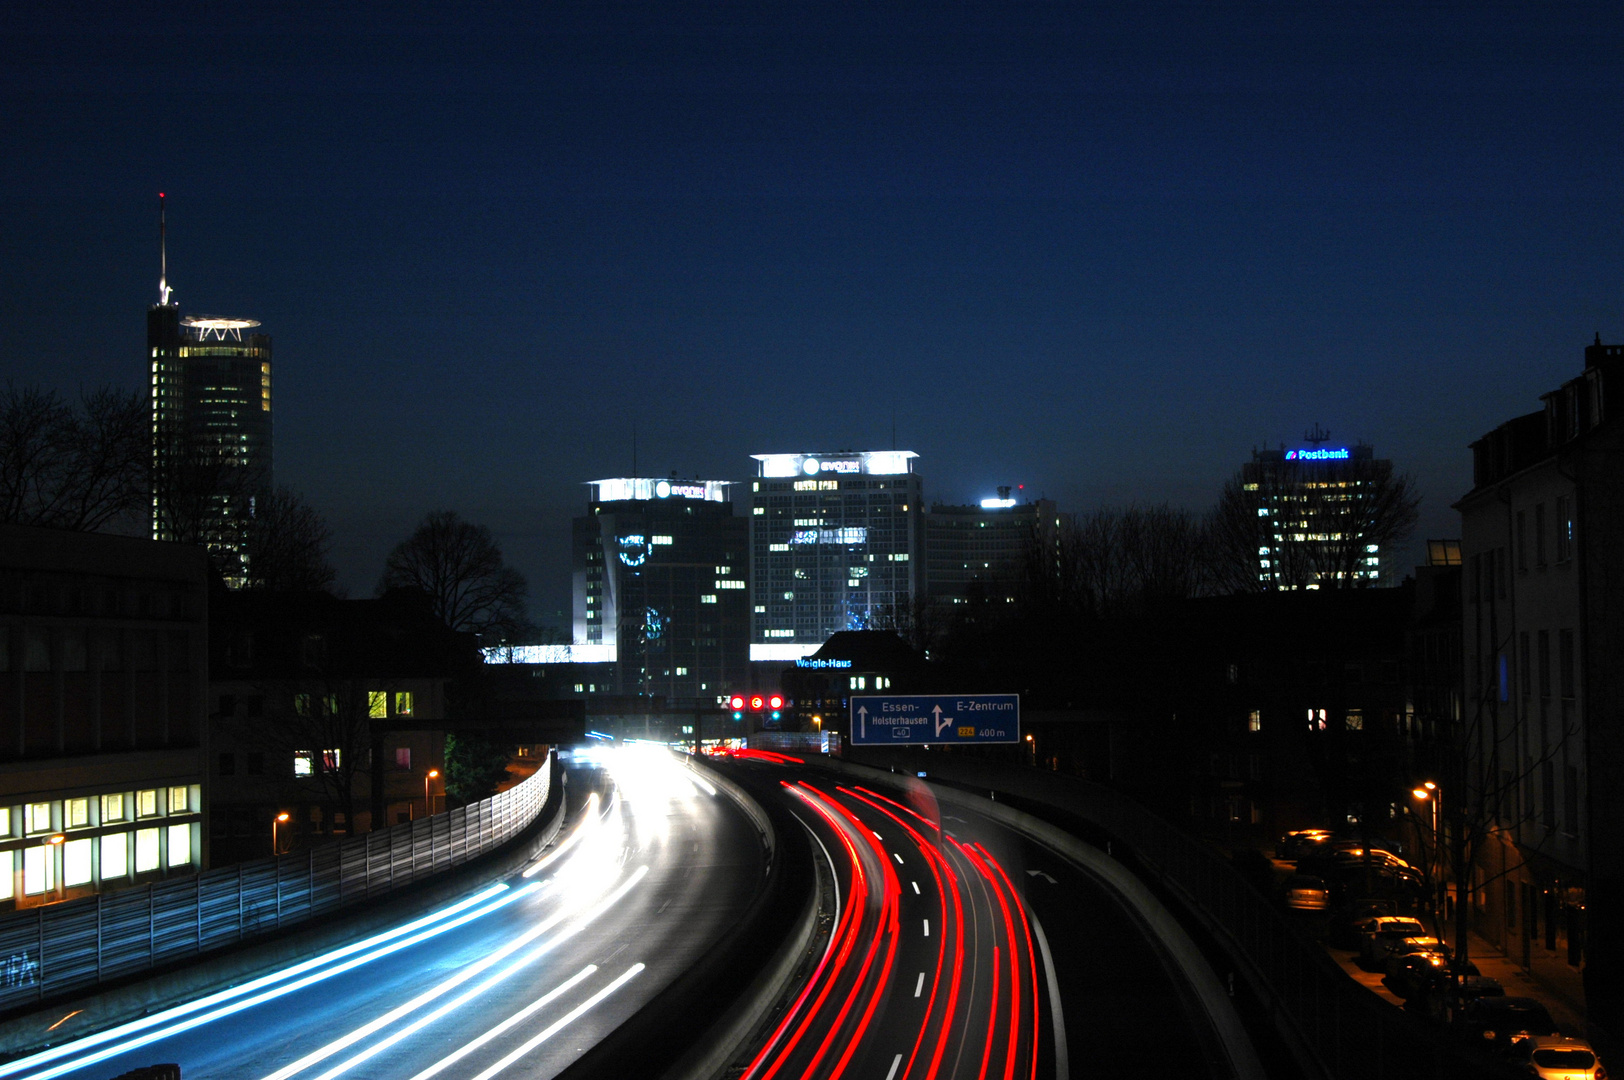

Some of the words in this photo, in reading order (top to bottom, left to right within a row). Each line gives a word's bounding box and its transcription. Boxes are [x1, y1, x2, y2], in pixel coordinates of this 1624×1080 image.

[1298, 448, 1349, 459] Postbank
[795, 659, 852, 669] Weigle-Haus
[882, 702, 920, 712] Essen-
[956, 701, 1014, 711] E-Zentrum
[872, 716, 928, 726] Holsterhausen
[896, 729, 906, 737] 40
[959, 728, 974, 736] 224
[979, 729, 996, 738] 400
